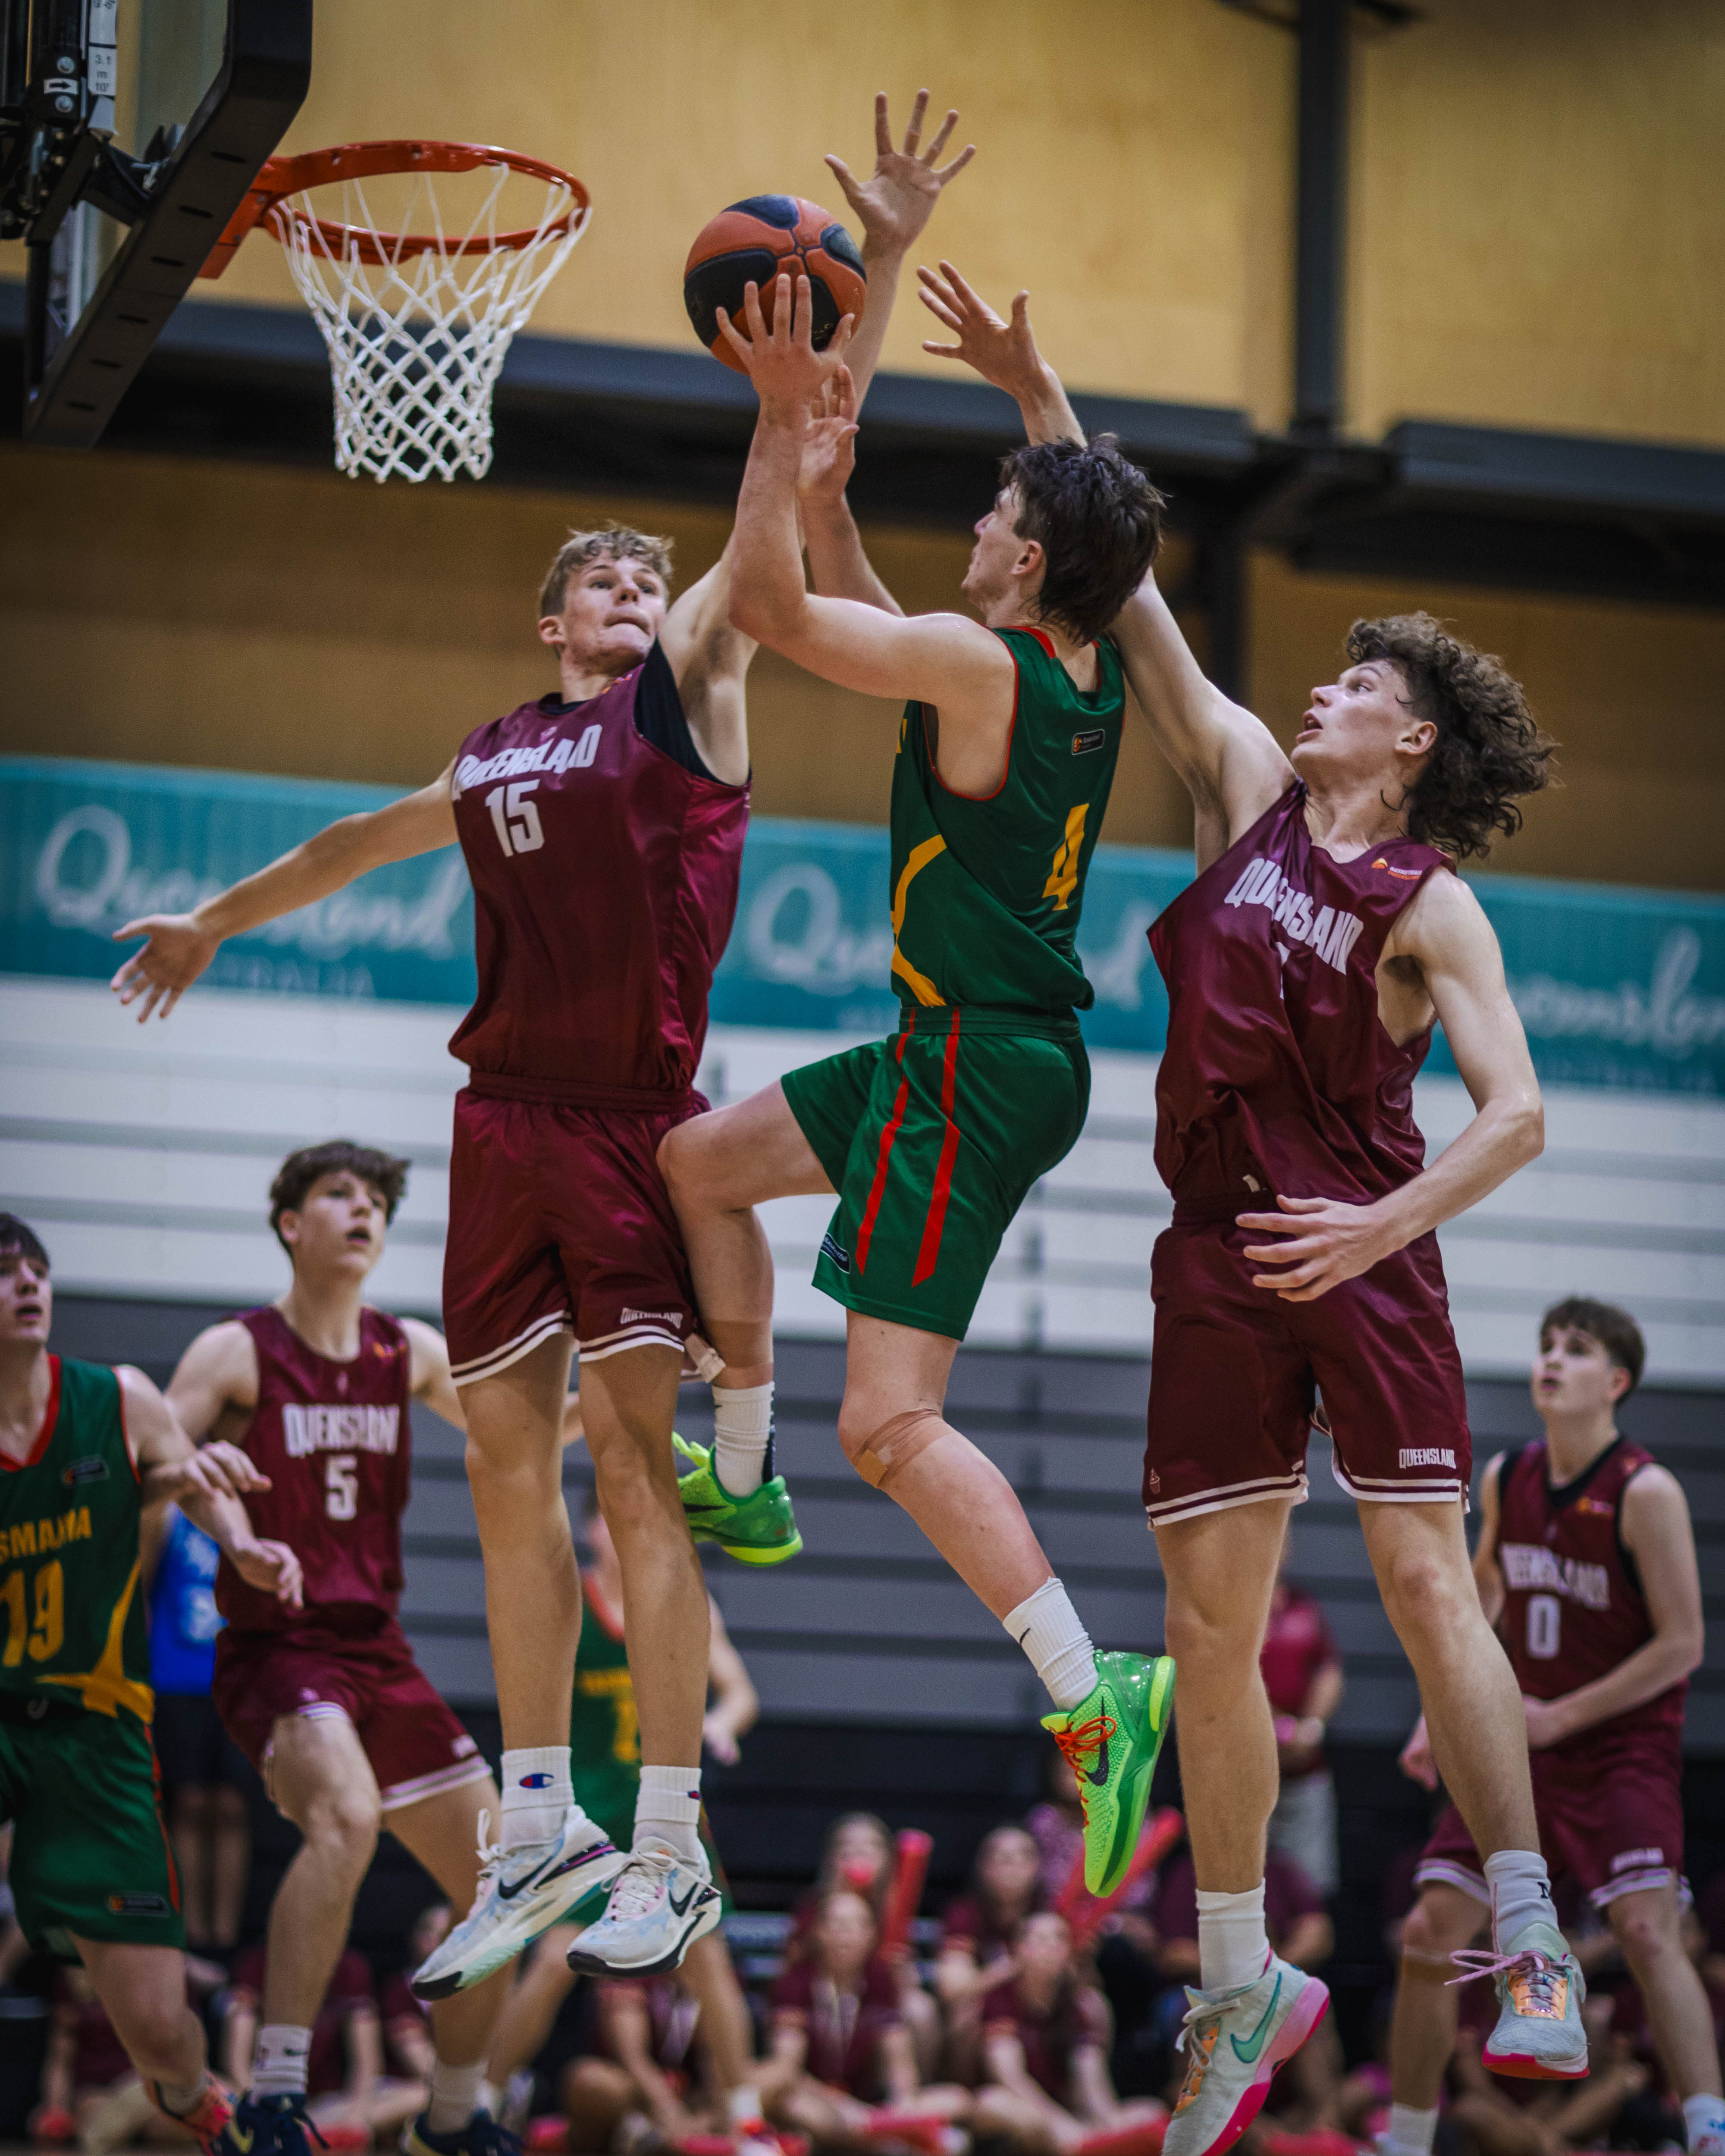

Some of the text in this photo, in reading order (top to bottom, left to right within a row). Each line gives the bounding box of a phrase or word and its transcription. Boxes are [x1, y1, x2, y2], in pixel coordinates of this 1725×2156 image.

[485, 779, 545, 858] 15
[1041, 803, 1090, 911] 4
[326, 1455, 359, 1521] 5
[1399, 1448, 1456, 1469] QUEENSLAND
[0, 1559, 64, 1667] 19
[1526, 1595, 1561, 1659] 0
